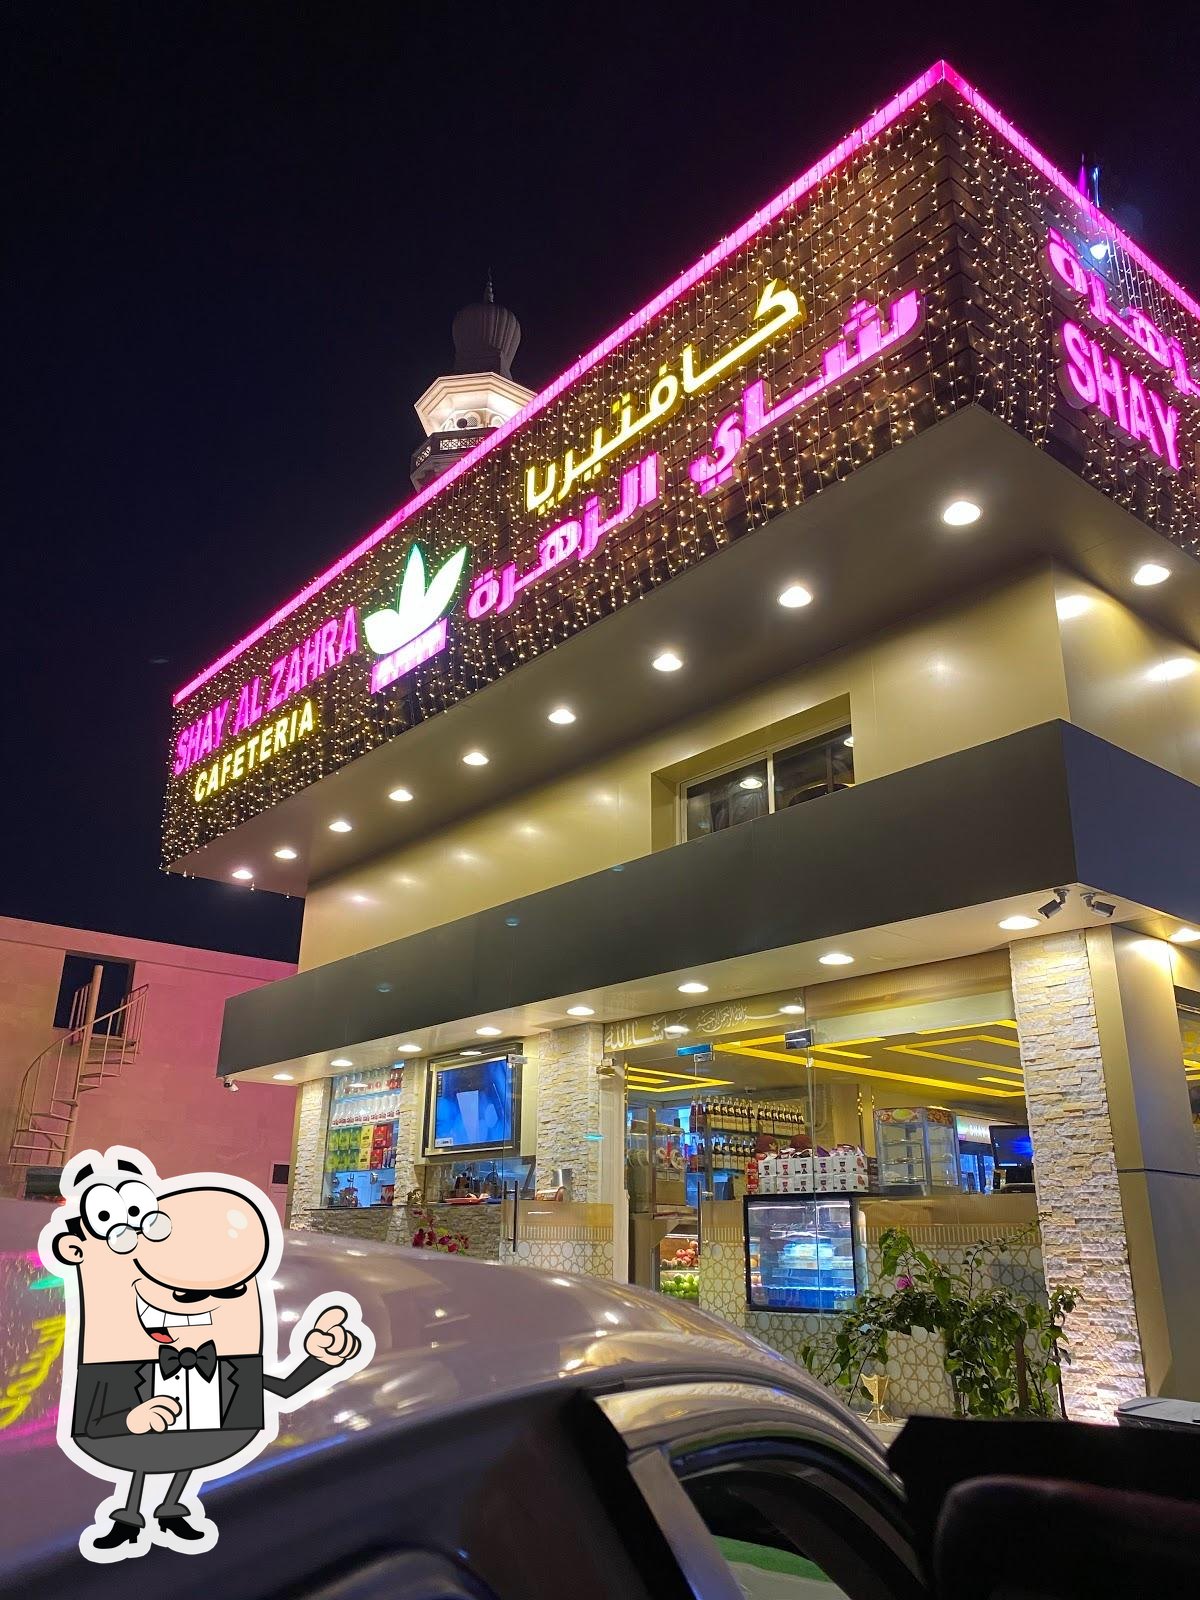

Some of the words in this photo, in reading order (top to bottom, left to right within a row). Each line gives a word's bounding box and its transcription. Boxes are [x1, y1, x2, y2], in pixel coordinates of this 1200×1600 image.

[525, 277, 801, 516] كافتيريا
[689, 289, 920, 495] شاي
[1049, 226, 1200, 397] زهرة
[1063, 321, 1181, 471] SHAY
[467, 452, 658, 619] الزهرة
[173, 699, 231, 776] SHAY
[232, 676, 263, 736] AL
[265, 605, 358, 713] ZAHRA
[194, 700, 314, 803] CAFETERIA
